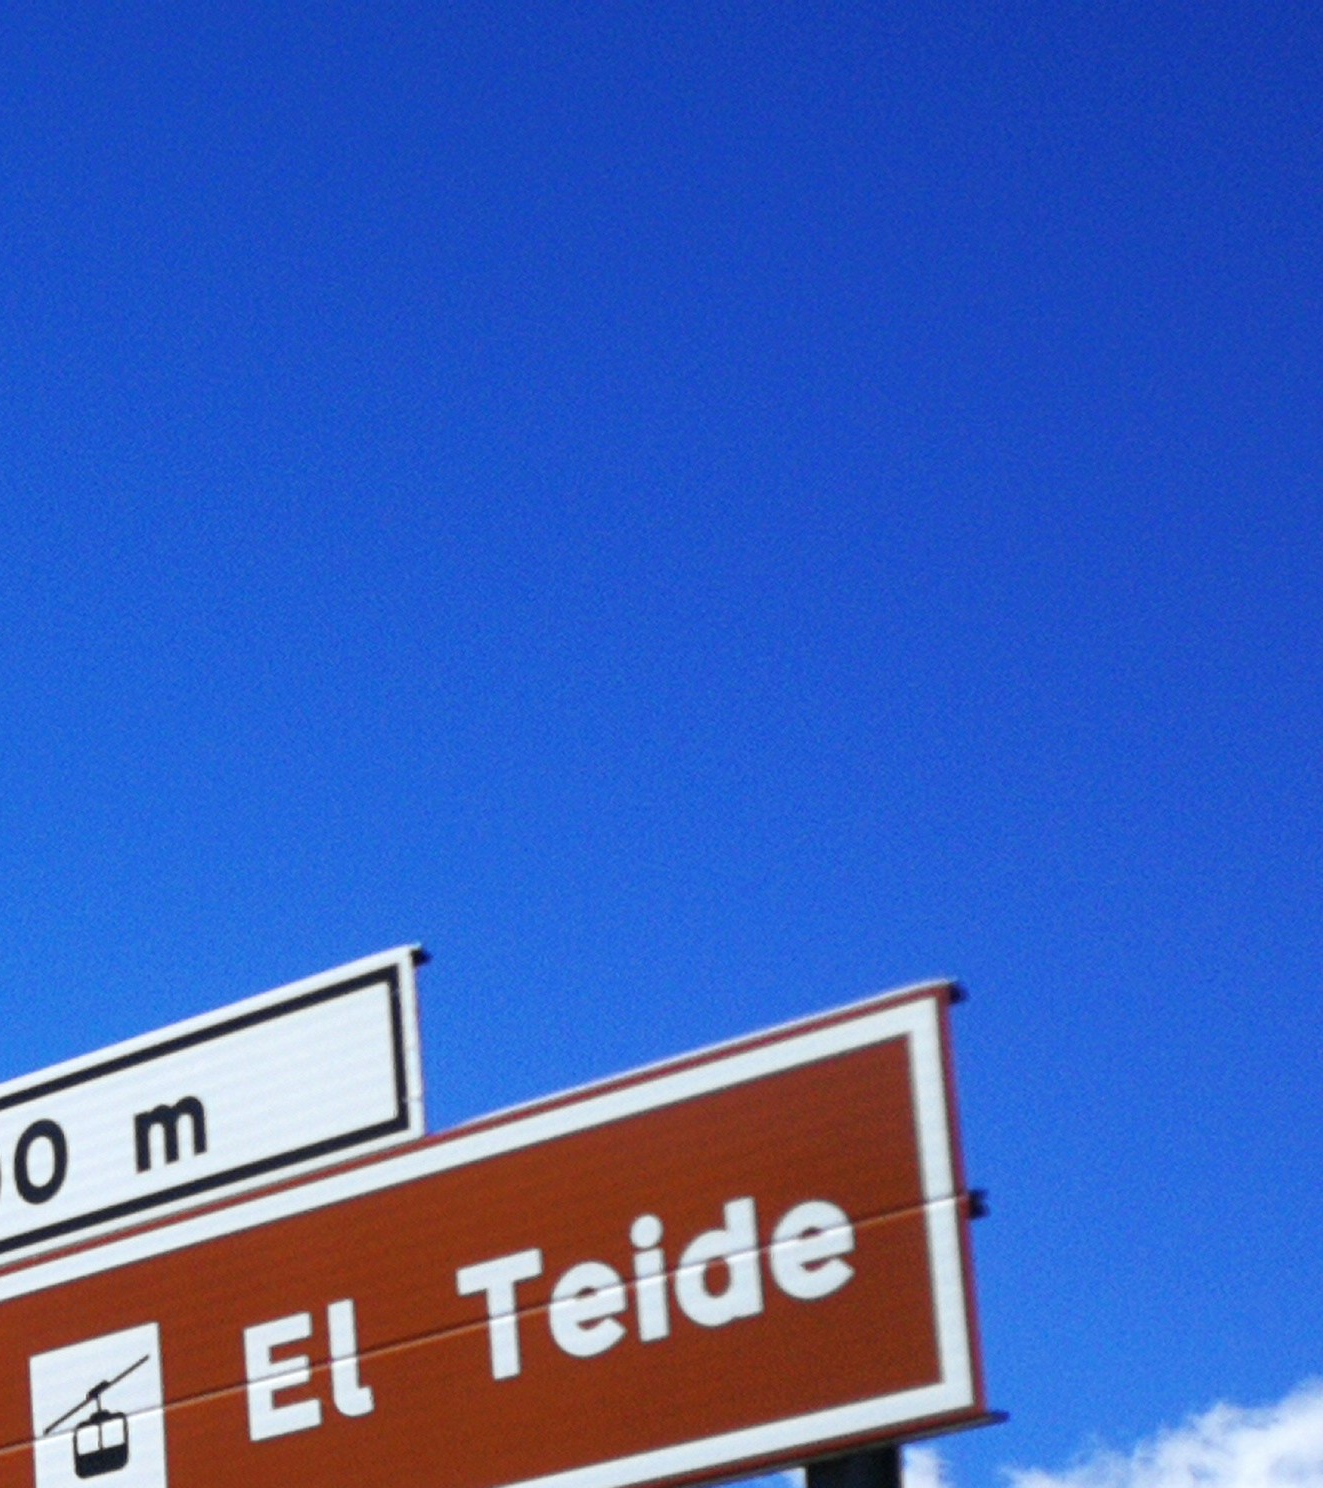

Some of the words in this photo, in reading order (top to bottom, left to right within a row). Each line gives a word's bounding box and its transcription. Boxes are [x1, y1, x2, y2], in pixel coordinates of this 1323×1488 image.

[135, 1095, 208, 1172] m
[243, 1299, 374, 1442] El
[456, 1196, 856, 1380] Teide
